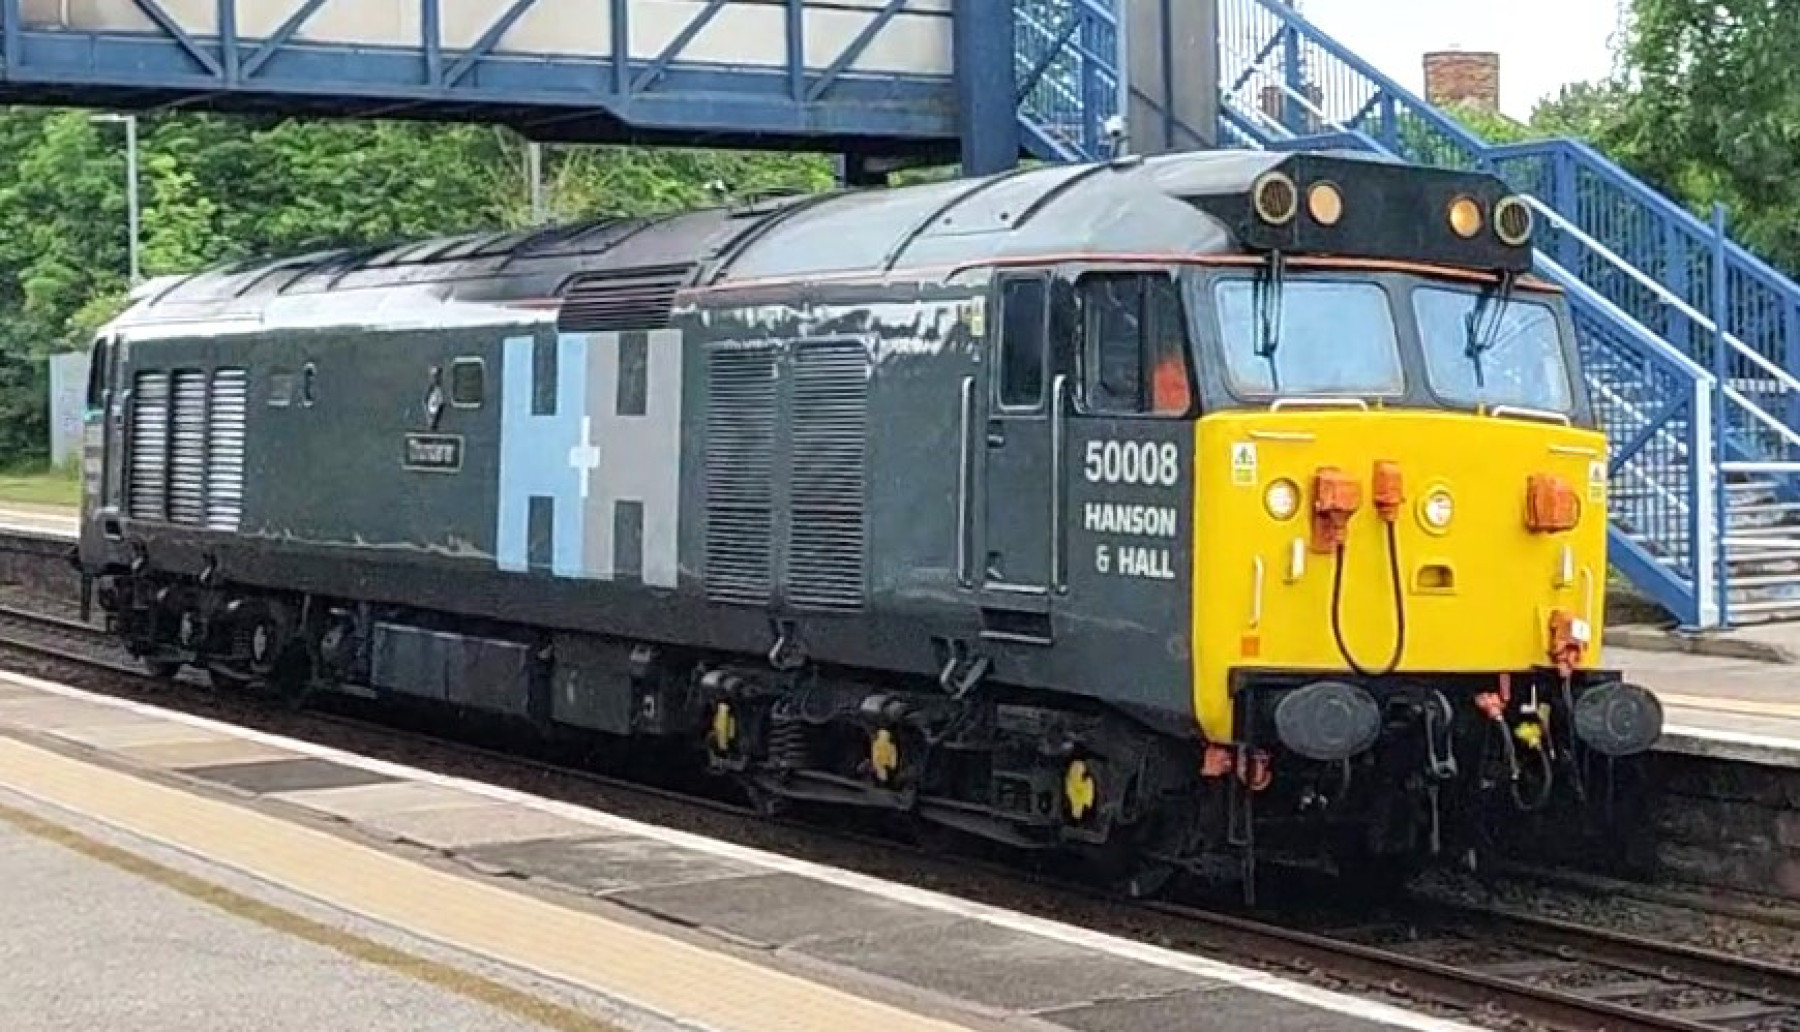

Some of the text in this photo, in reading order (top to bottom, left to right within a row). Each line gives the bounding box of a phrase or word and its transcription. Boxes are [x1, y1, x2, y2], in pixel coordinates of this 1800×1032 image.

[1084, 440, 1178, 485] 50008
[1085, 502, 1176, 537] HANSON
[1096, 544, 1175, 579] & HALL
